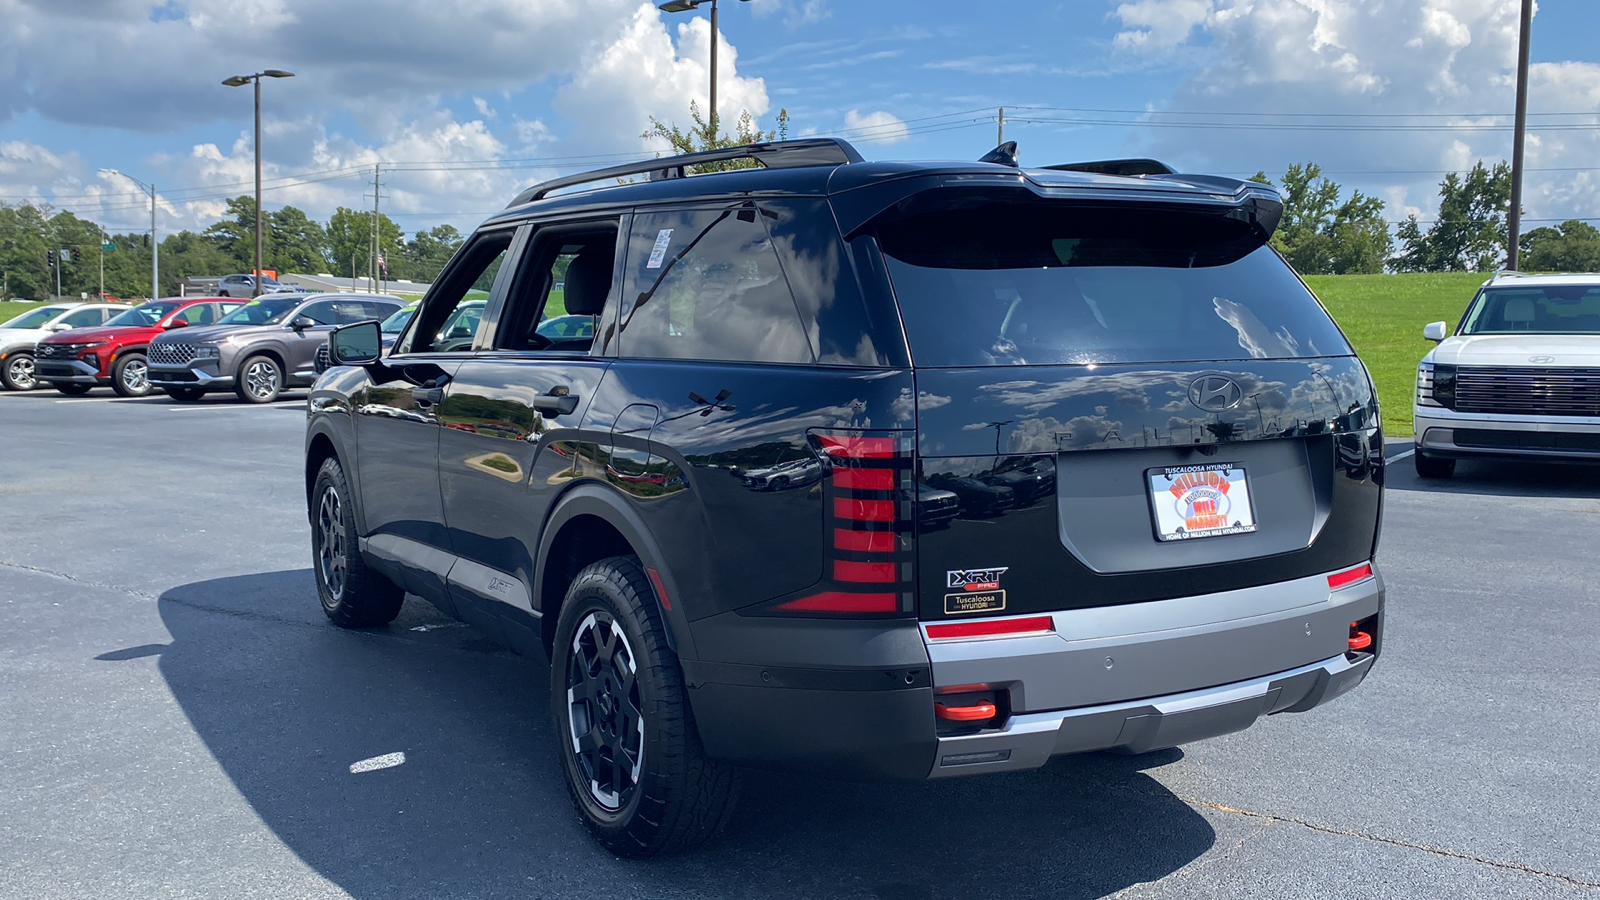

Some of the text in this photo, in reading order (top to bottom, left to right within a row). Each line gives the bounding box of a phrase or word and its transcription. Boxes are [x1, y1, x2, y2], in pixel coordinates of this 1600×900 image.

[1165, 463, 1233, 474] TUSCALOOSA HYUNDAI
[1169, 471, 1231, 500] MILLION
[1192, 500, 1217, 516] MILE
[1185, 514, 1227, 530] WARRANTY
[1190, 530, 1211, 538] MILLION
[947, 566, 1009, 588] XRT
[955, 595, 995, 604] Tuscaloosa
[961, 602, 988, 610] HYUNDAI
